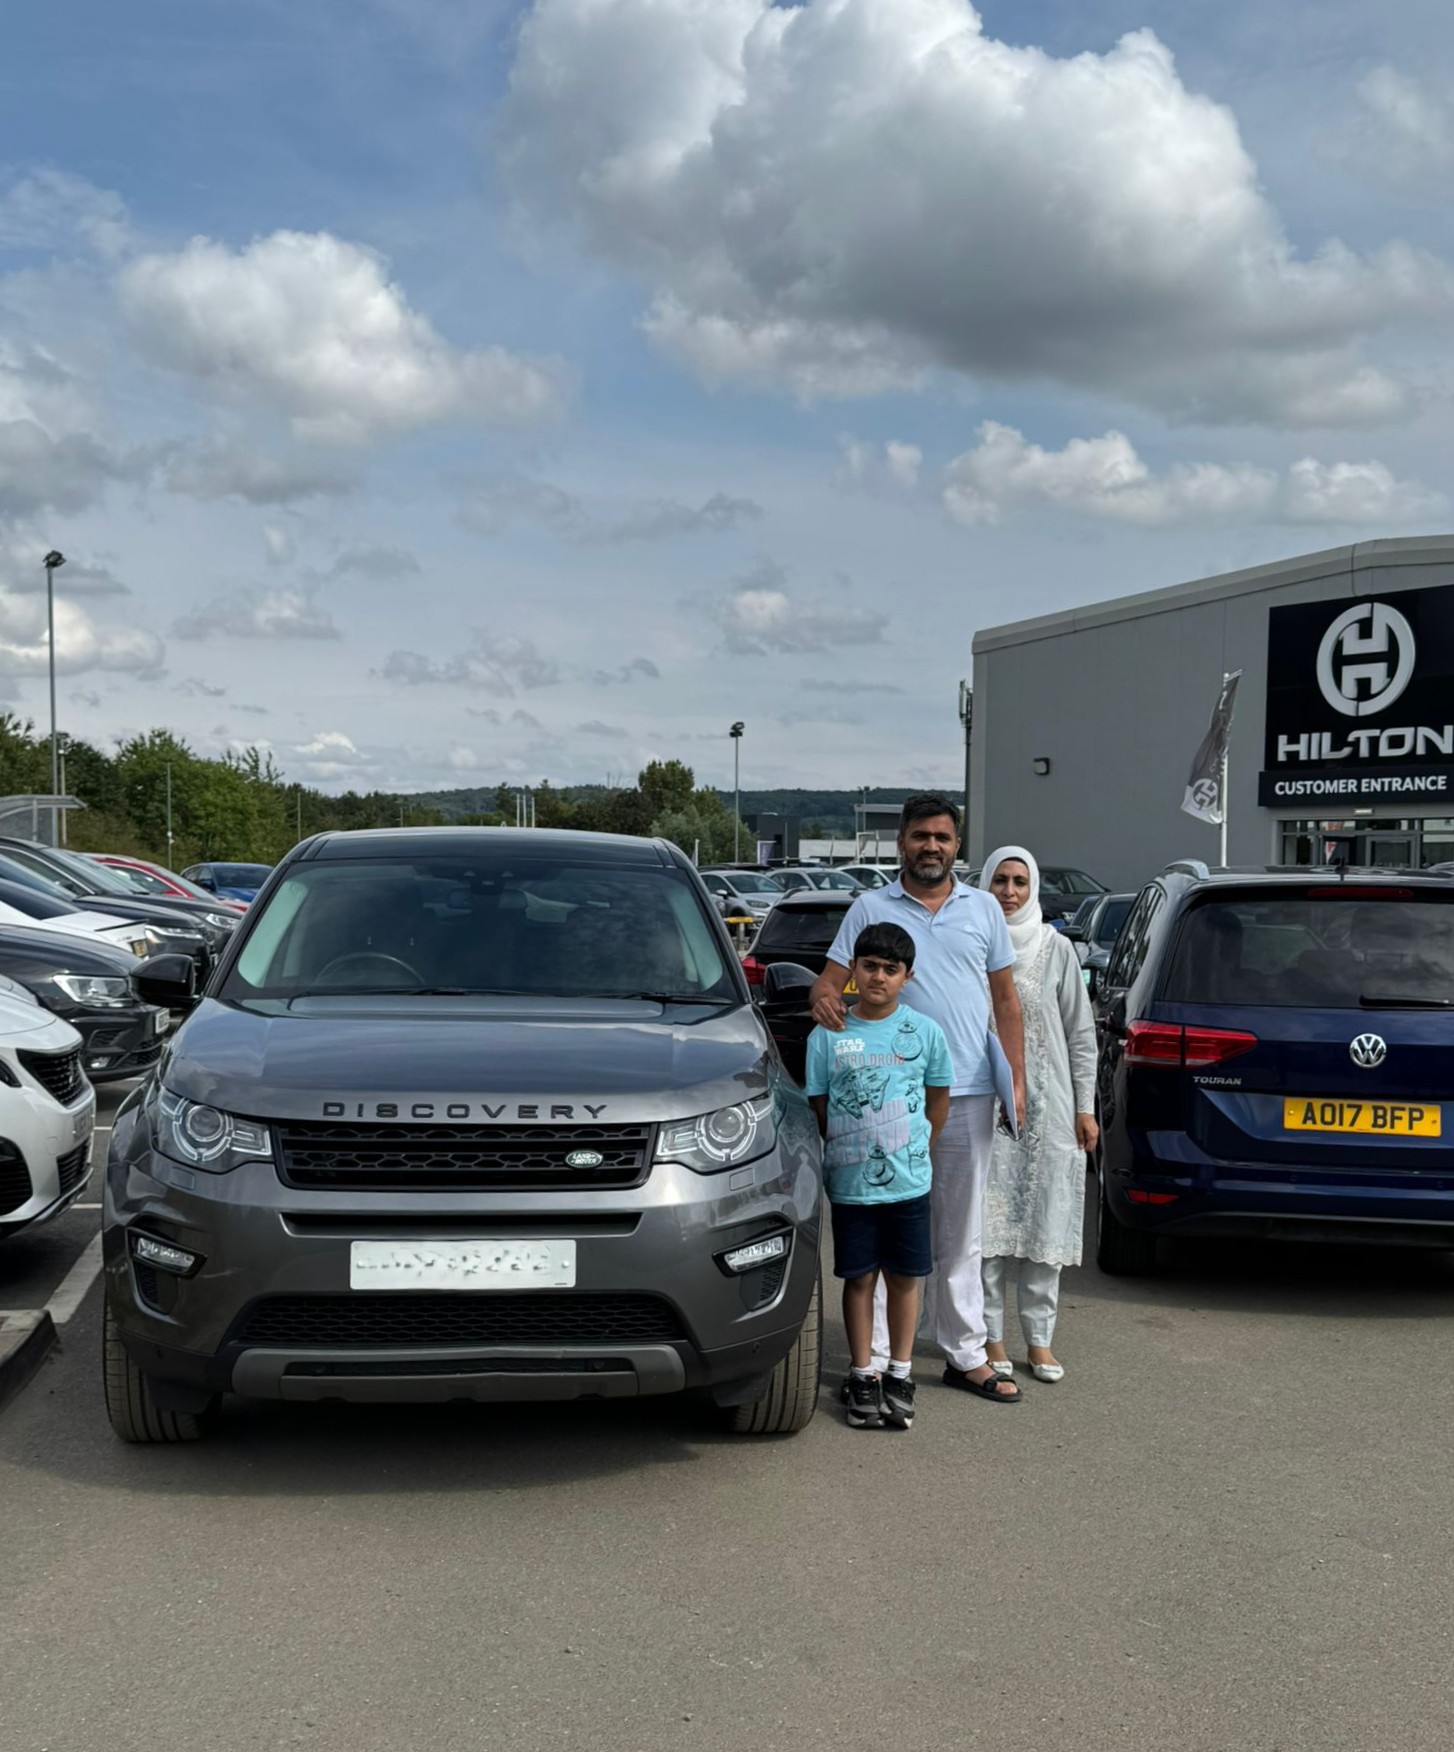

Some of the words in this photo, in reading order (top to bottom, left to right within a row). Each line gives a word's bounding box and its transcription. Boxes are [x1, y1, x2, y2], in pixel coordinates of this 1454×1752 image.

[1277, 725, 1454, 762] HILTON
[1274, 779, 1358, 796] CUSTOMER
[1361, 775, 1447, 793] ENTRANCE
[836, 1038, 865, 1047] STAR
[1192, 1076, 1242, 1086] TOURAN
[322, 1101, 608, 1120] DISCOVERY
[1302, 1102, 1362, 1128] AO17
[1371, 1105, 1424, 1131] BFP
